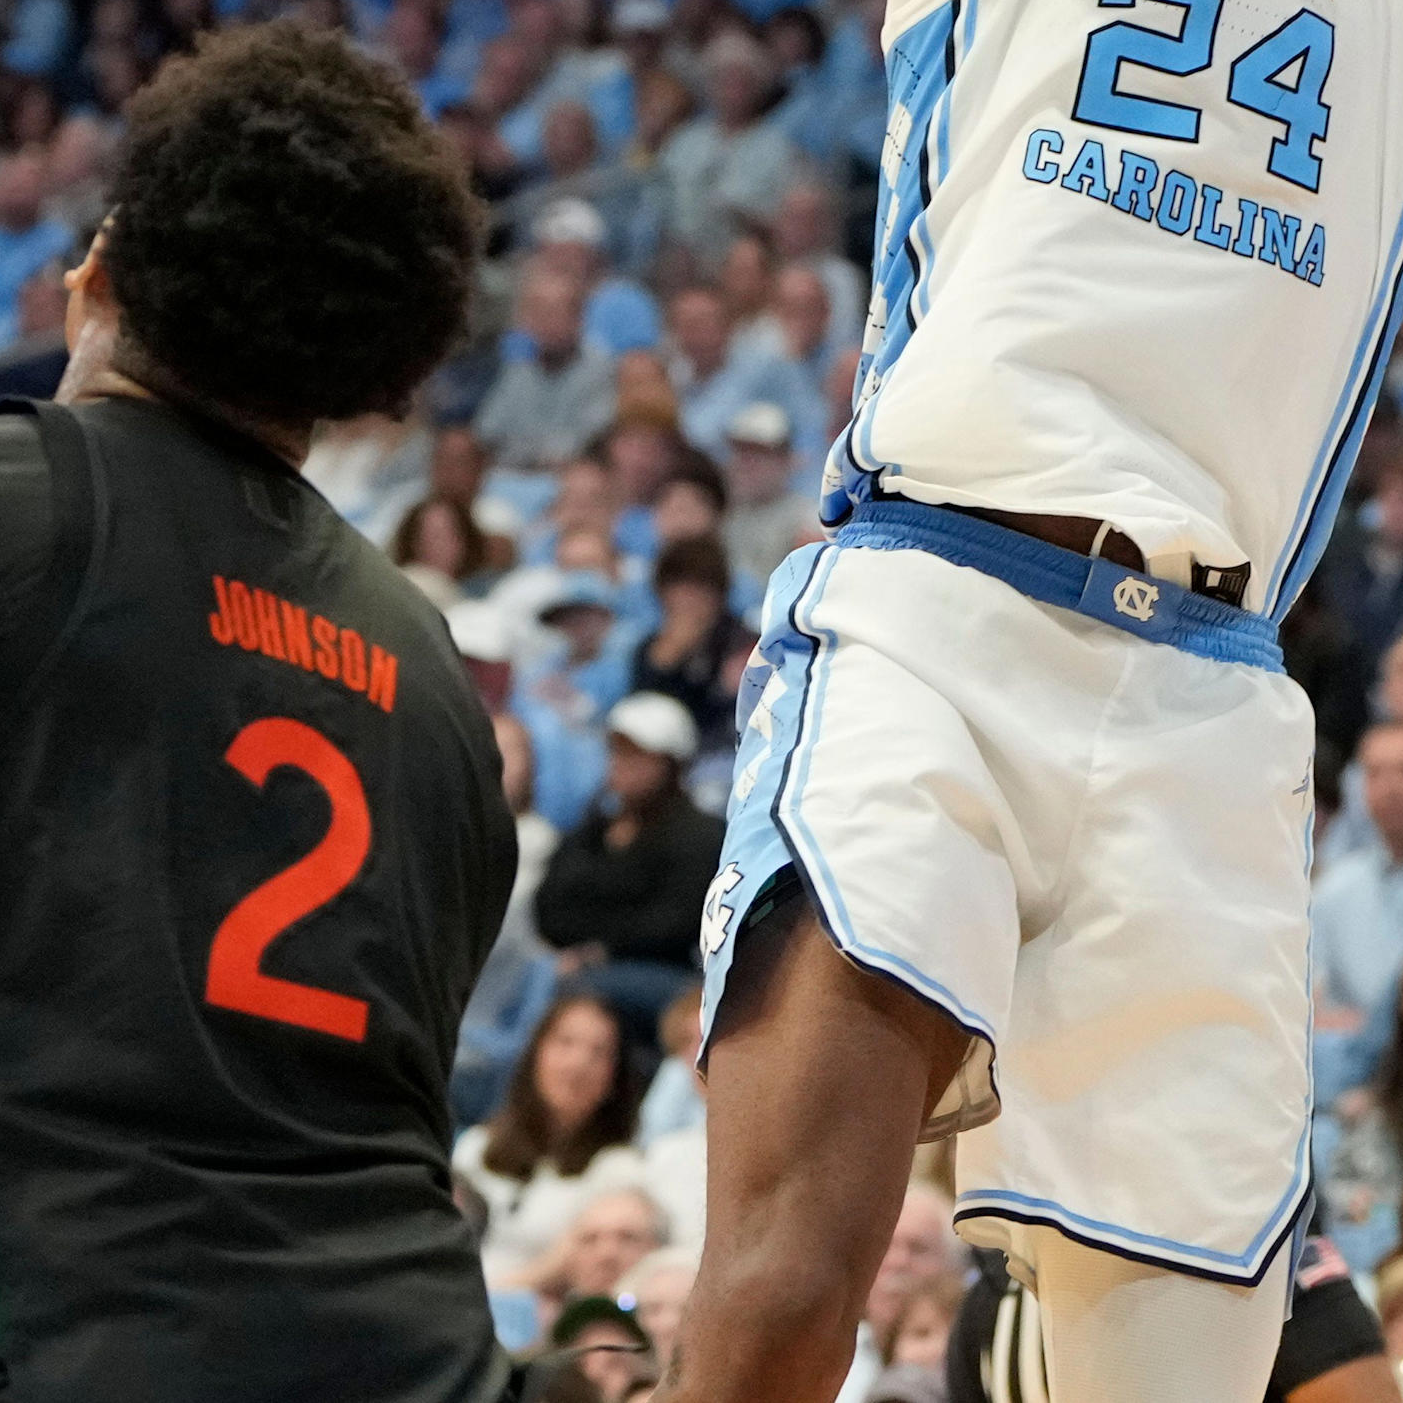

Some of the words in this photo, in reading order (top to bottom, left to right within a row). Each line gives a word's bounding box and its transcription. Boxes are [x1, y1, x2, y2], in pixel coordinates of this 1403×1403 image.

[1022, 127, 1327, 288] CAROLINA
[208, 575, 399, 714] JOHNSON
[205, 716, 372, 1043] 2
